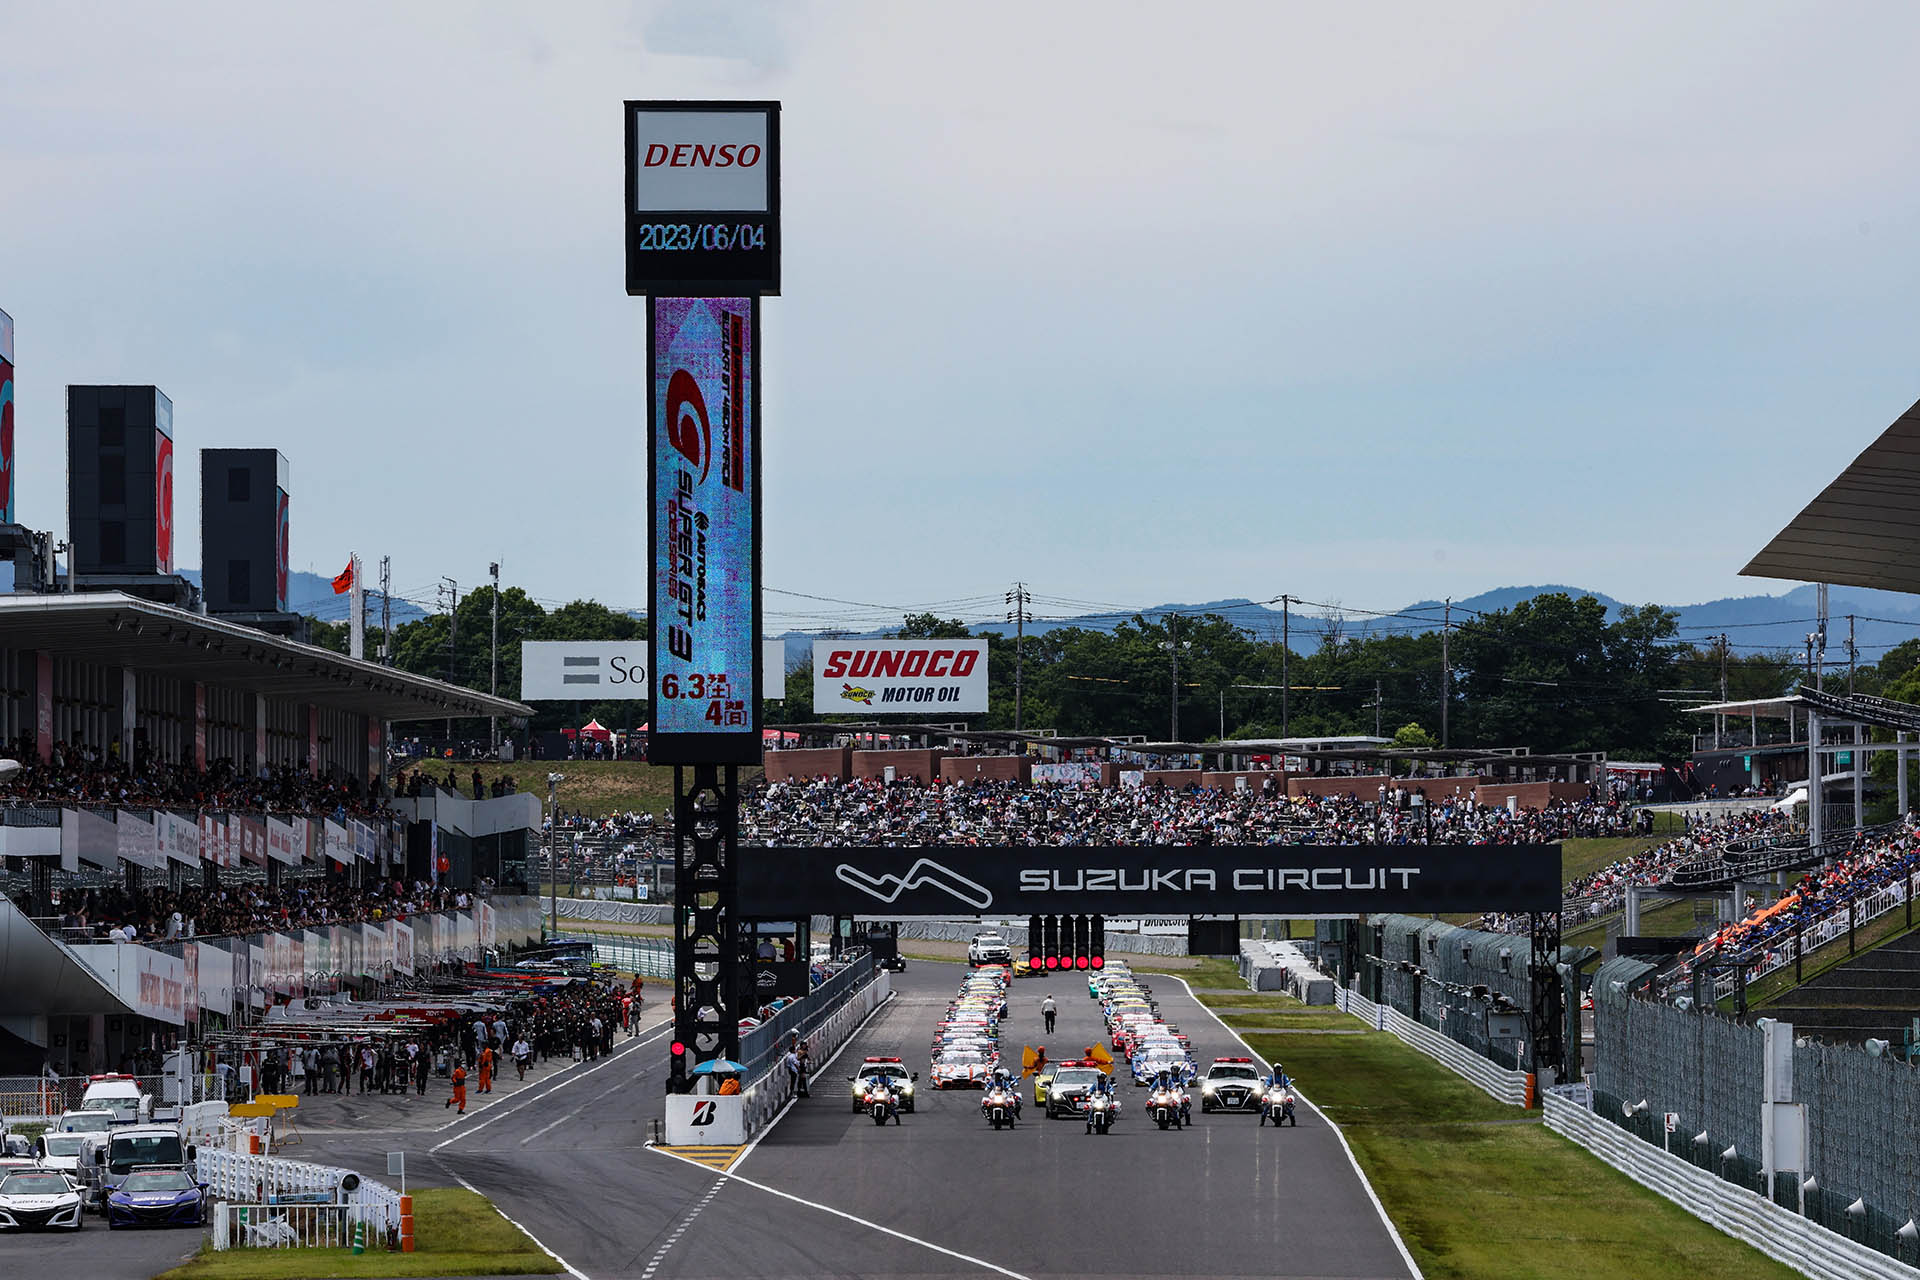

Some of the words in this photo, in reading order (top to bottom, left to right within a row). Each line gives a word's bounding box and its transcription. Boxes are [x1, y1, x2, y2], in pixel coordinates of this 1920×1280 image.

[644, 143, 761, 168] DENSO
[639, 223, 766, 250] 2023/06/04
[722, 310, 731, 371] SUZUKA
[678, 469, 693, 578] SUPER
[697, 530, 707, 622] AUTOBACS
[678, 581, 693, 628] GT
[609, 656, 646, 684] So
[823, 649, 980, 678] SUNOCO
[662, 673, 705, 699] 6.3
[840, 690, 876, 699] SUNOCO
[881, 687, 935, 702] MOTOR
[937, 687, 960, 702] OIL
[705, 700, 722, 725] 4
[1019, 868, 1217, 891] SUZUKA
[1233, 868, 1421, 891] CIRCUIT
